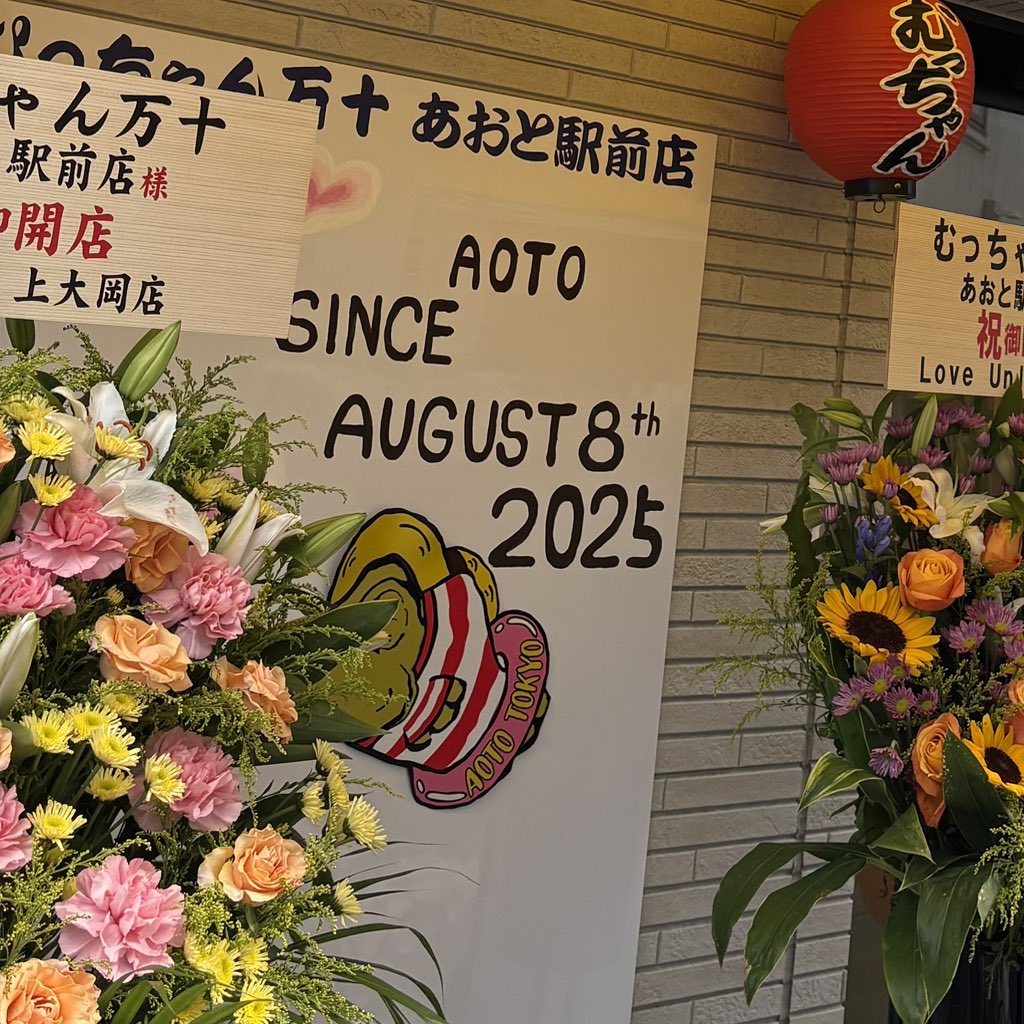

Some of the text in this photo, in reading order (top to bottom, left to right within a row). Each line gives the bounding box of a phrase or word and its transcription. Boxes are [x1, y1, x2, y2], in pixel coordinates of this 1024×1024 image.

[412, 92, 698, 189] あおと駅前店
[13, 267, 165, 316] 上大岡店
[449, 234, 586, 301] AOTO
[276, 289, 459, 365] SINCE
[920, 356, 974, 387] Love
[323, 393, 661, 472] AUGUST 8th
[488, 483, 665, 569] 2025
[465, 638, 545, 797] AOTO TOKYO
